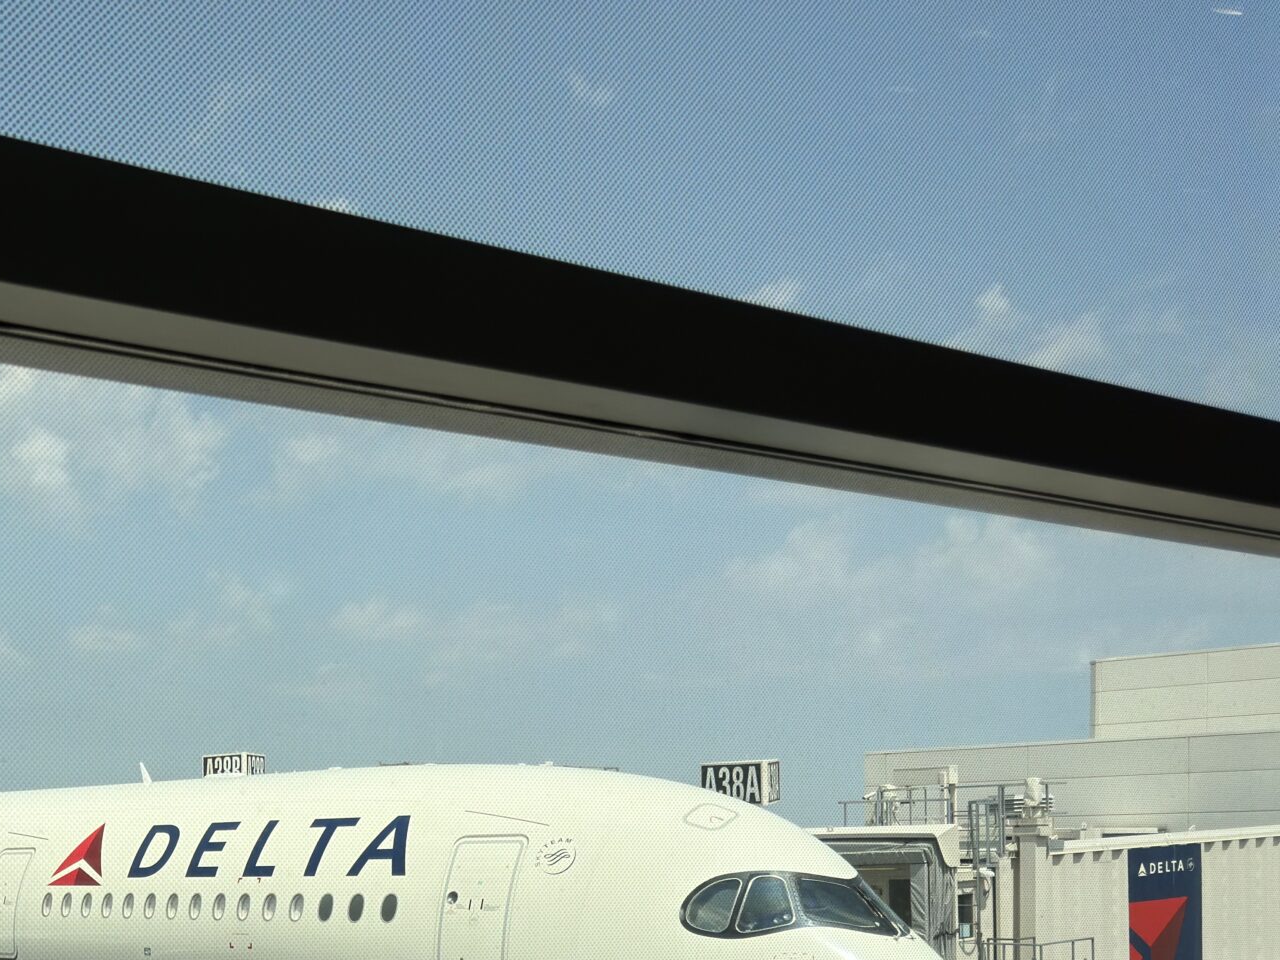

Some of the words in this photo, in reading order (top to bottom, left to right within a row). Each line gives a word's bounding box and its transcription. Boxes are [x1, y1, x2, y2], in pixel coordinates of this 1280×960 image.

[705, 765, 761, 802] A38A
[127, 815, 411, 878] DELTA
[1149, 859, 1185, 875] DELTA
